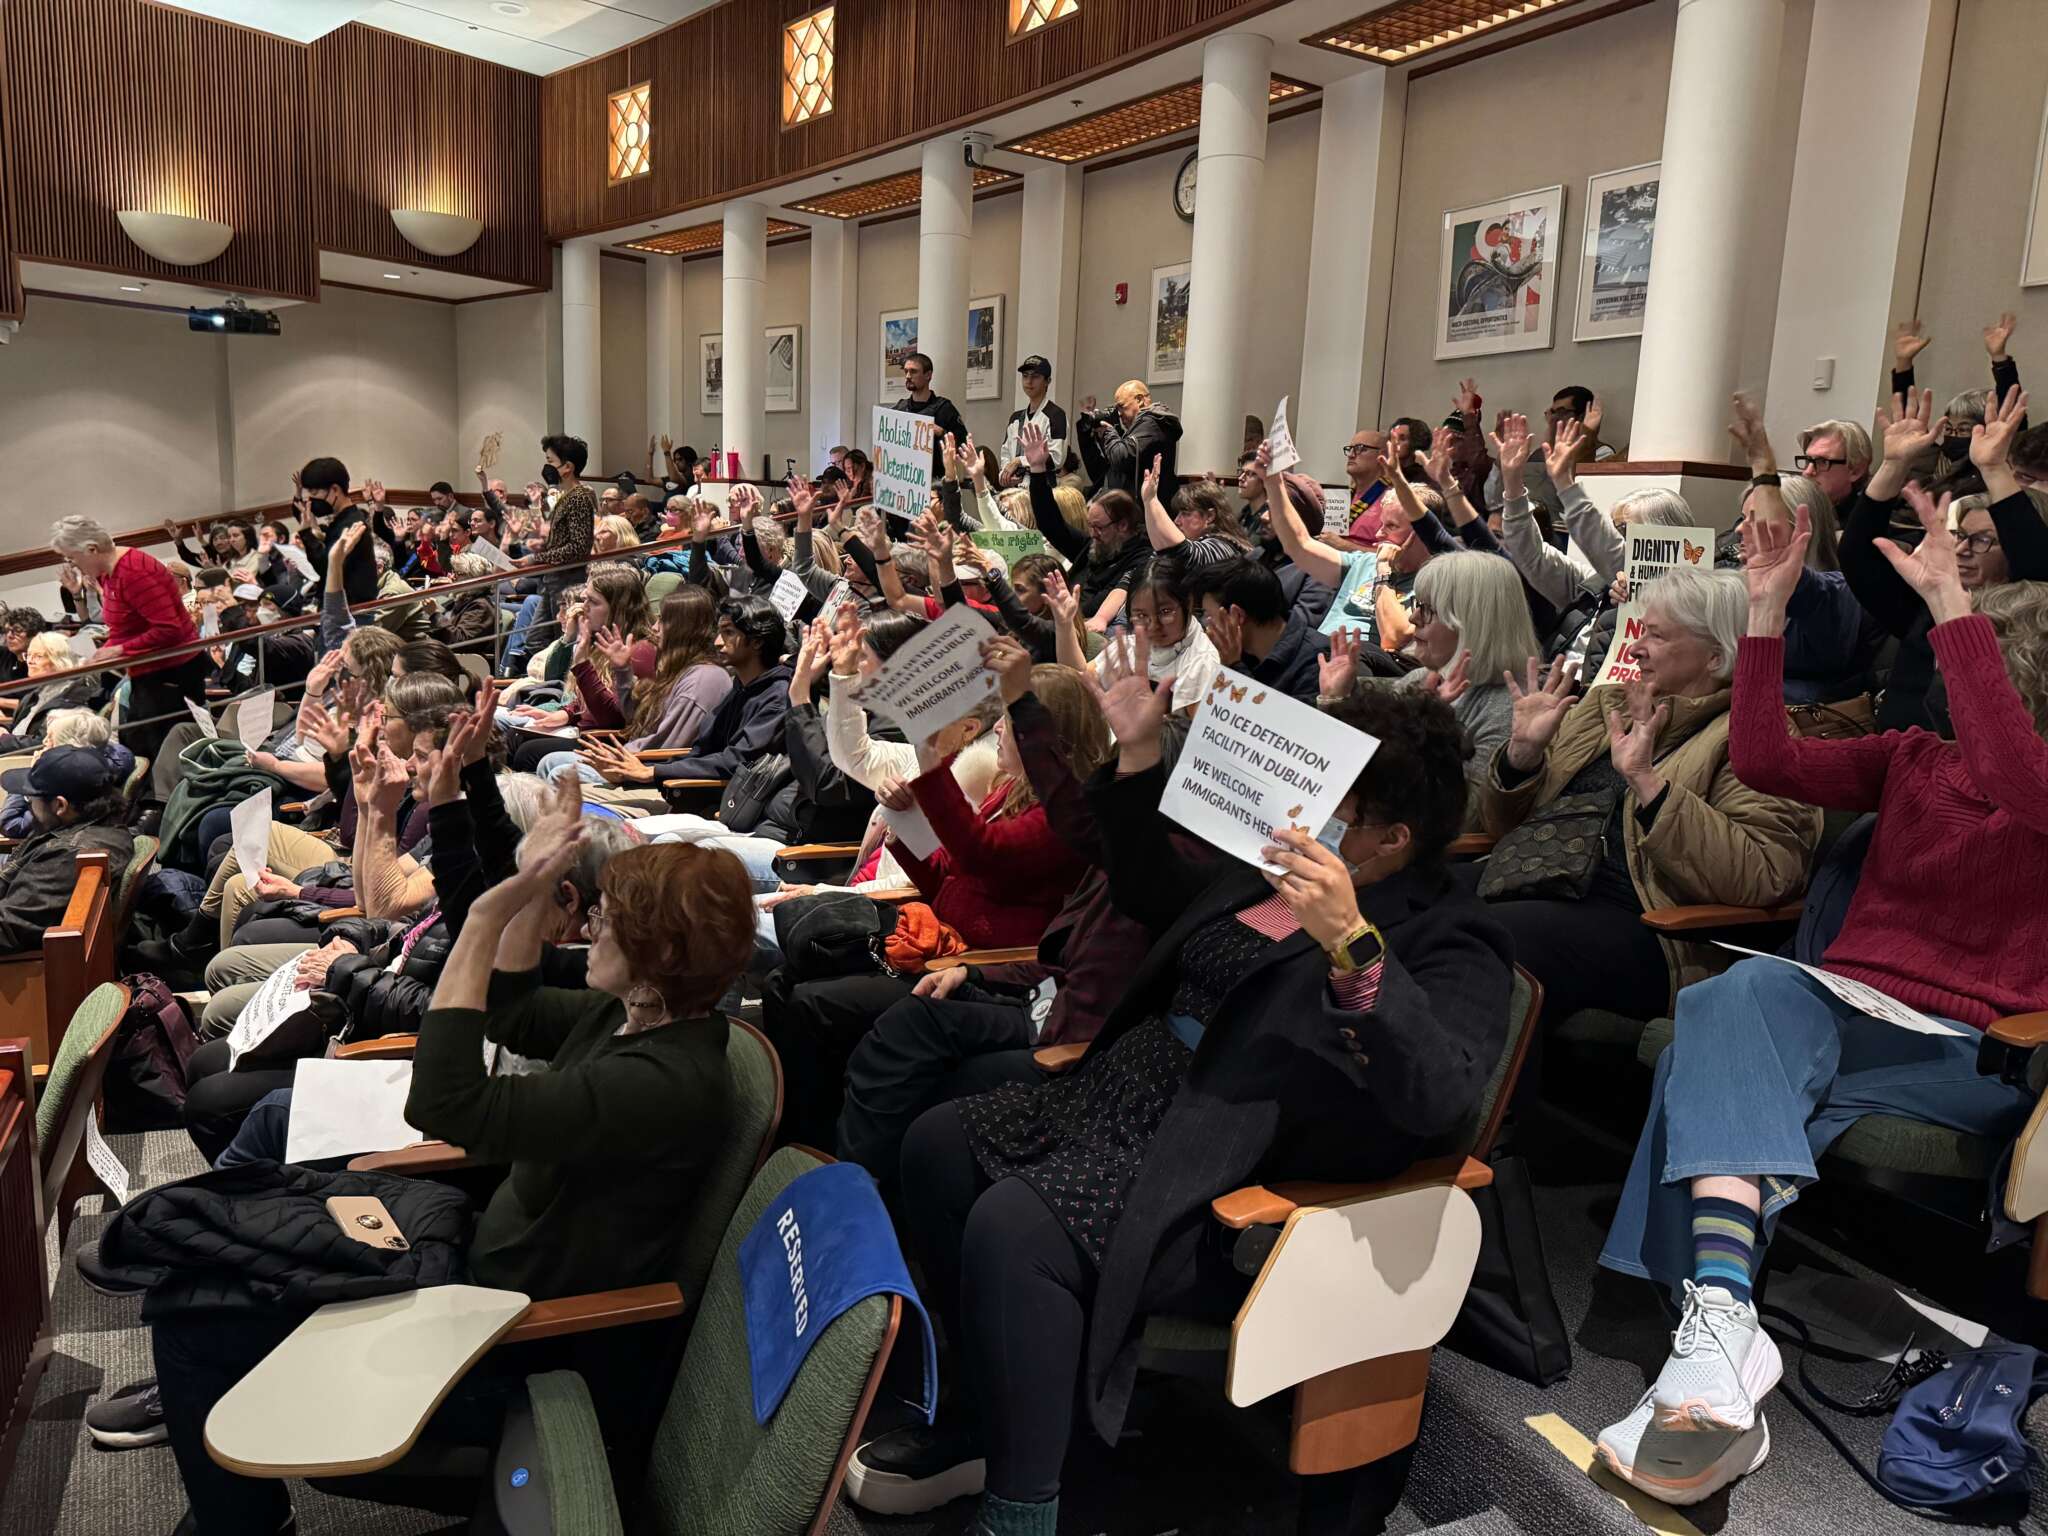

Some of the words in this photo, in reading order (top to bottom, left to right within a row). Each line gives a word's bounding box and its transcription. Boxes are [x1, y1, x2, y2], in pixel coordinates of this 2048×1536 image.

[878, 415, 912, 449] Abolish
[913, 420, 933, 454] ICE
[883, 449, 926, 487] Detention
[1008, 533, 1039, 552] right
[1632, 538, 1680, 564] DIGNITY
[1628, 581, 1643, 602] FO
[1630, 565, 1636, 579] &
[902, 623, 963, 671] DETENTION
[921, 657, 936, 670] IN
[934, 627, 977, 661] DUBLIN!
[1625, 617, 1645, 640] N
[1616, 642, 1640, 665] IC
[894, 695, 913, 708] WE
[911, 660, 964, 697] WELCOME
[905, 677, 967, 720] IMMIGRANTS
[1210, 703, 1230, 722] NO
[1229, 712, 1253, 733] ICE
[1249, 723, 1330, 773] DETENTION
[1193, 756, 1212, 776] WE
[1211, 766, 1265, 806] WELCOME
[1201, 726, 1251, 758] FACILITY
[1247, 749, 1265, 767] IN
[1264, 758, 1323, 798] DUBLIN!
[1181, 776, 1252, 825] IMMIGRANTS
[777, 1207, 808, 1338] RESERVED
